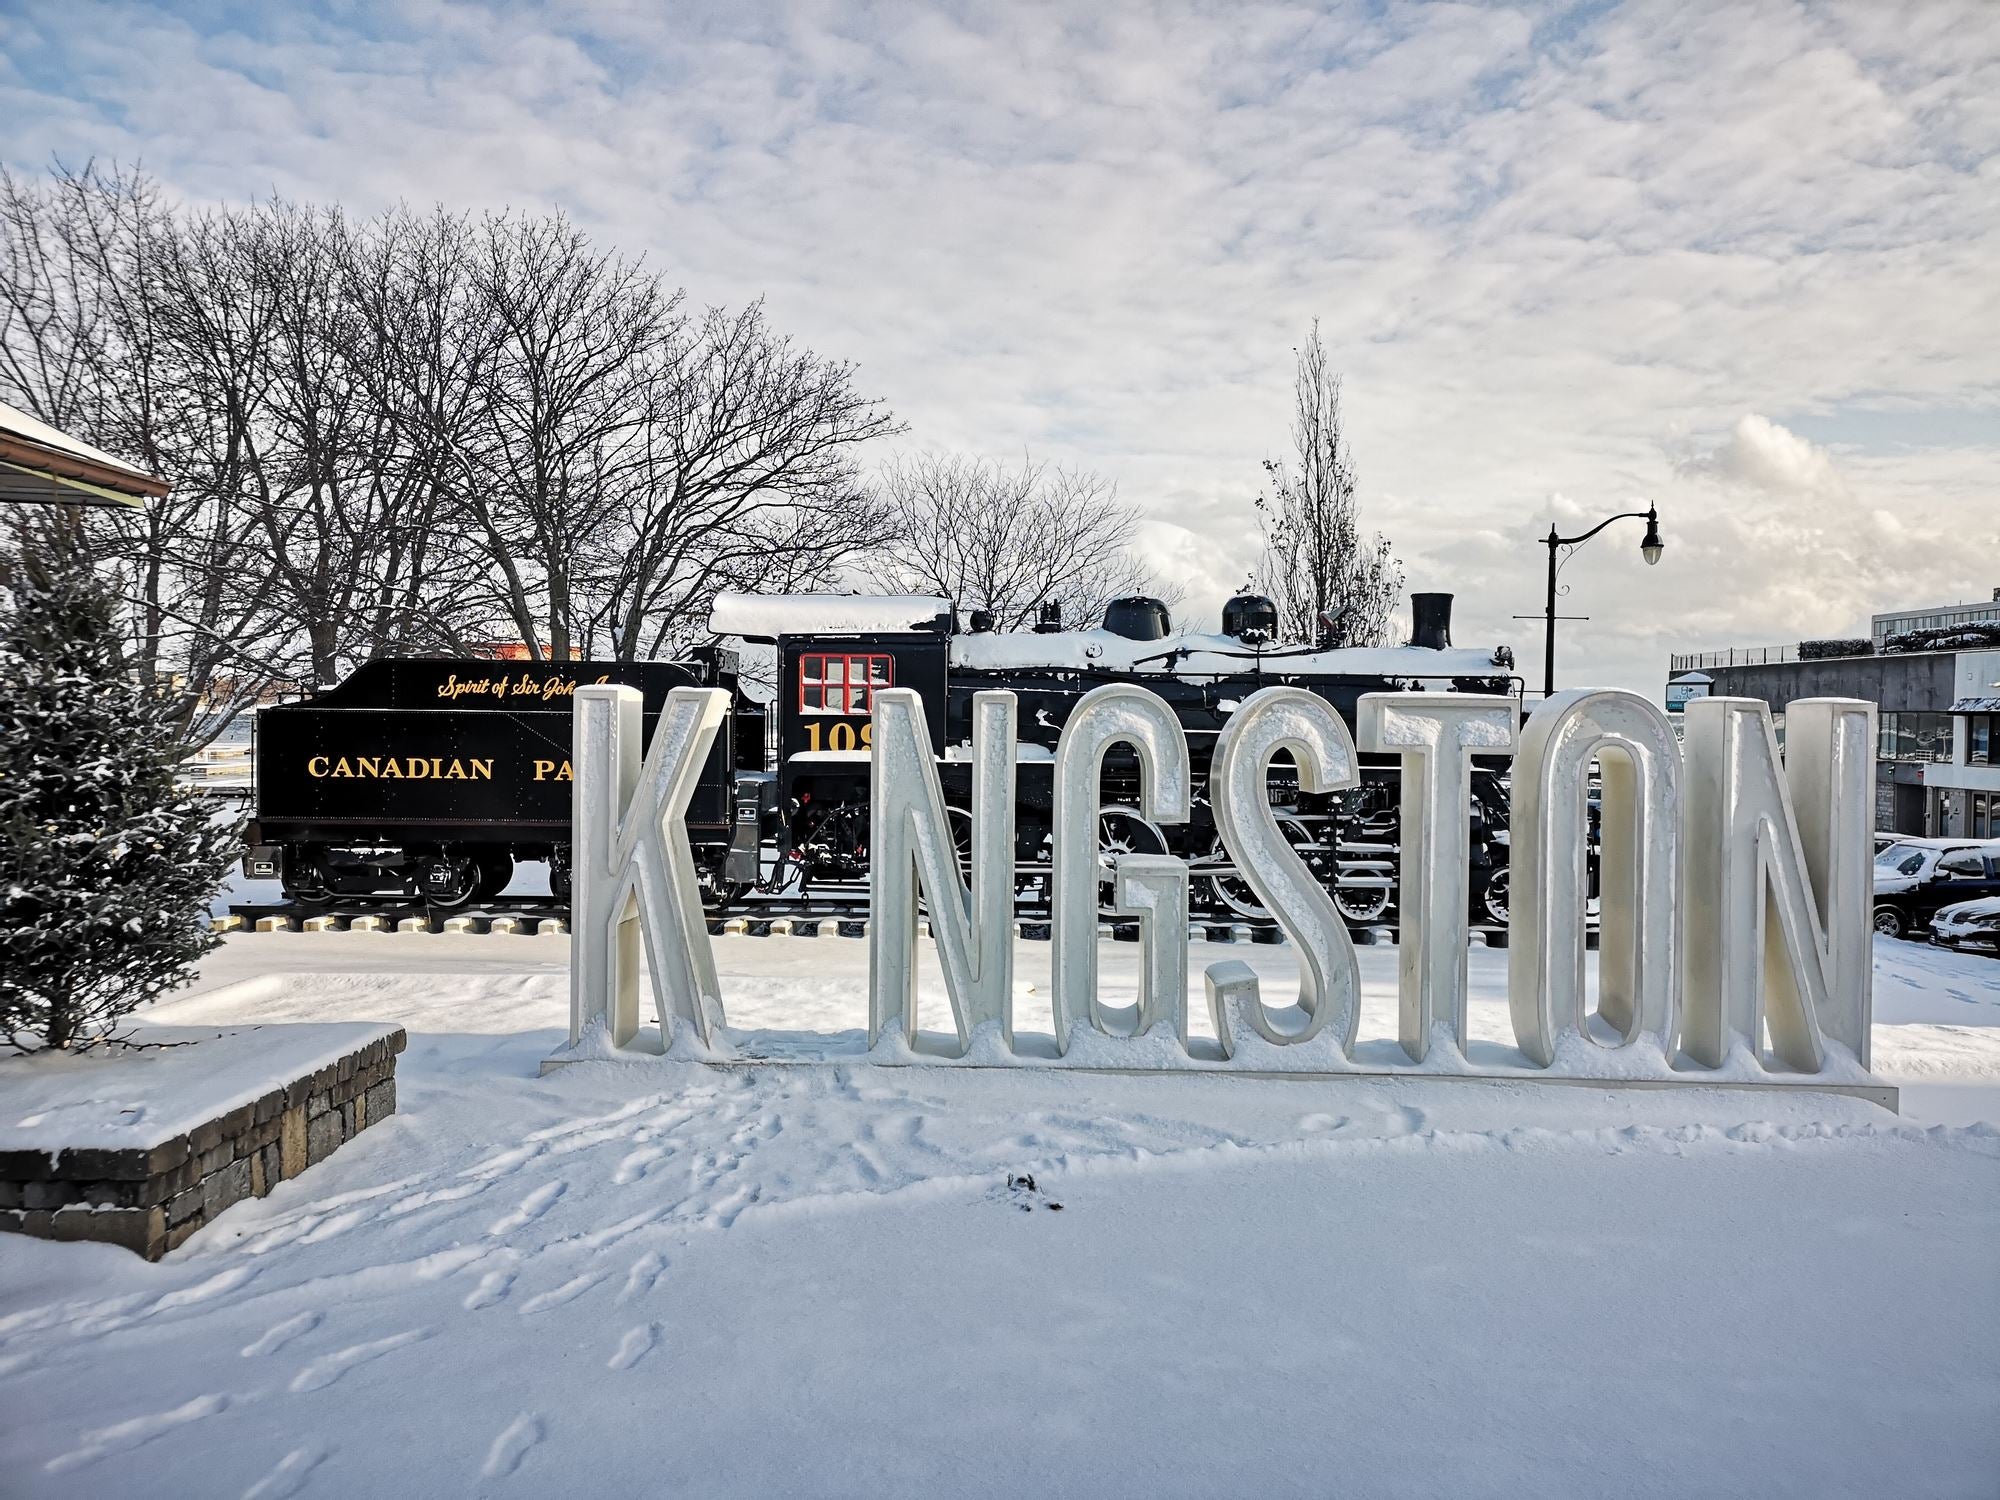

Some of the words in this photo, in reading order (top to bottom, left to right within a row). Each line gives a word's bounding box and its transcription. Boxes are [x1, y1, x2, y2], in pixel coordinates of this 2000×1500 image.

[438, 675, 490, 699] Spirit
[491, 676, 508, 698] of
[511, 674, 540, 695] Sir
[542, 677, 576, 700] Joh
[307, 757, 494, 780] CANADIAN
